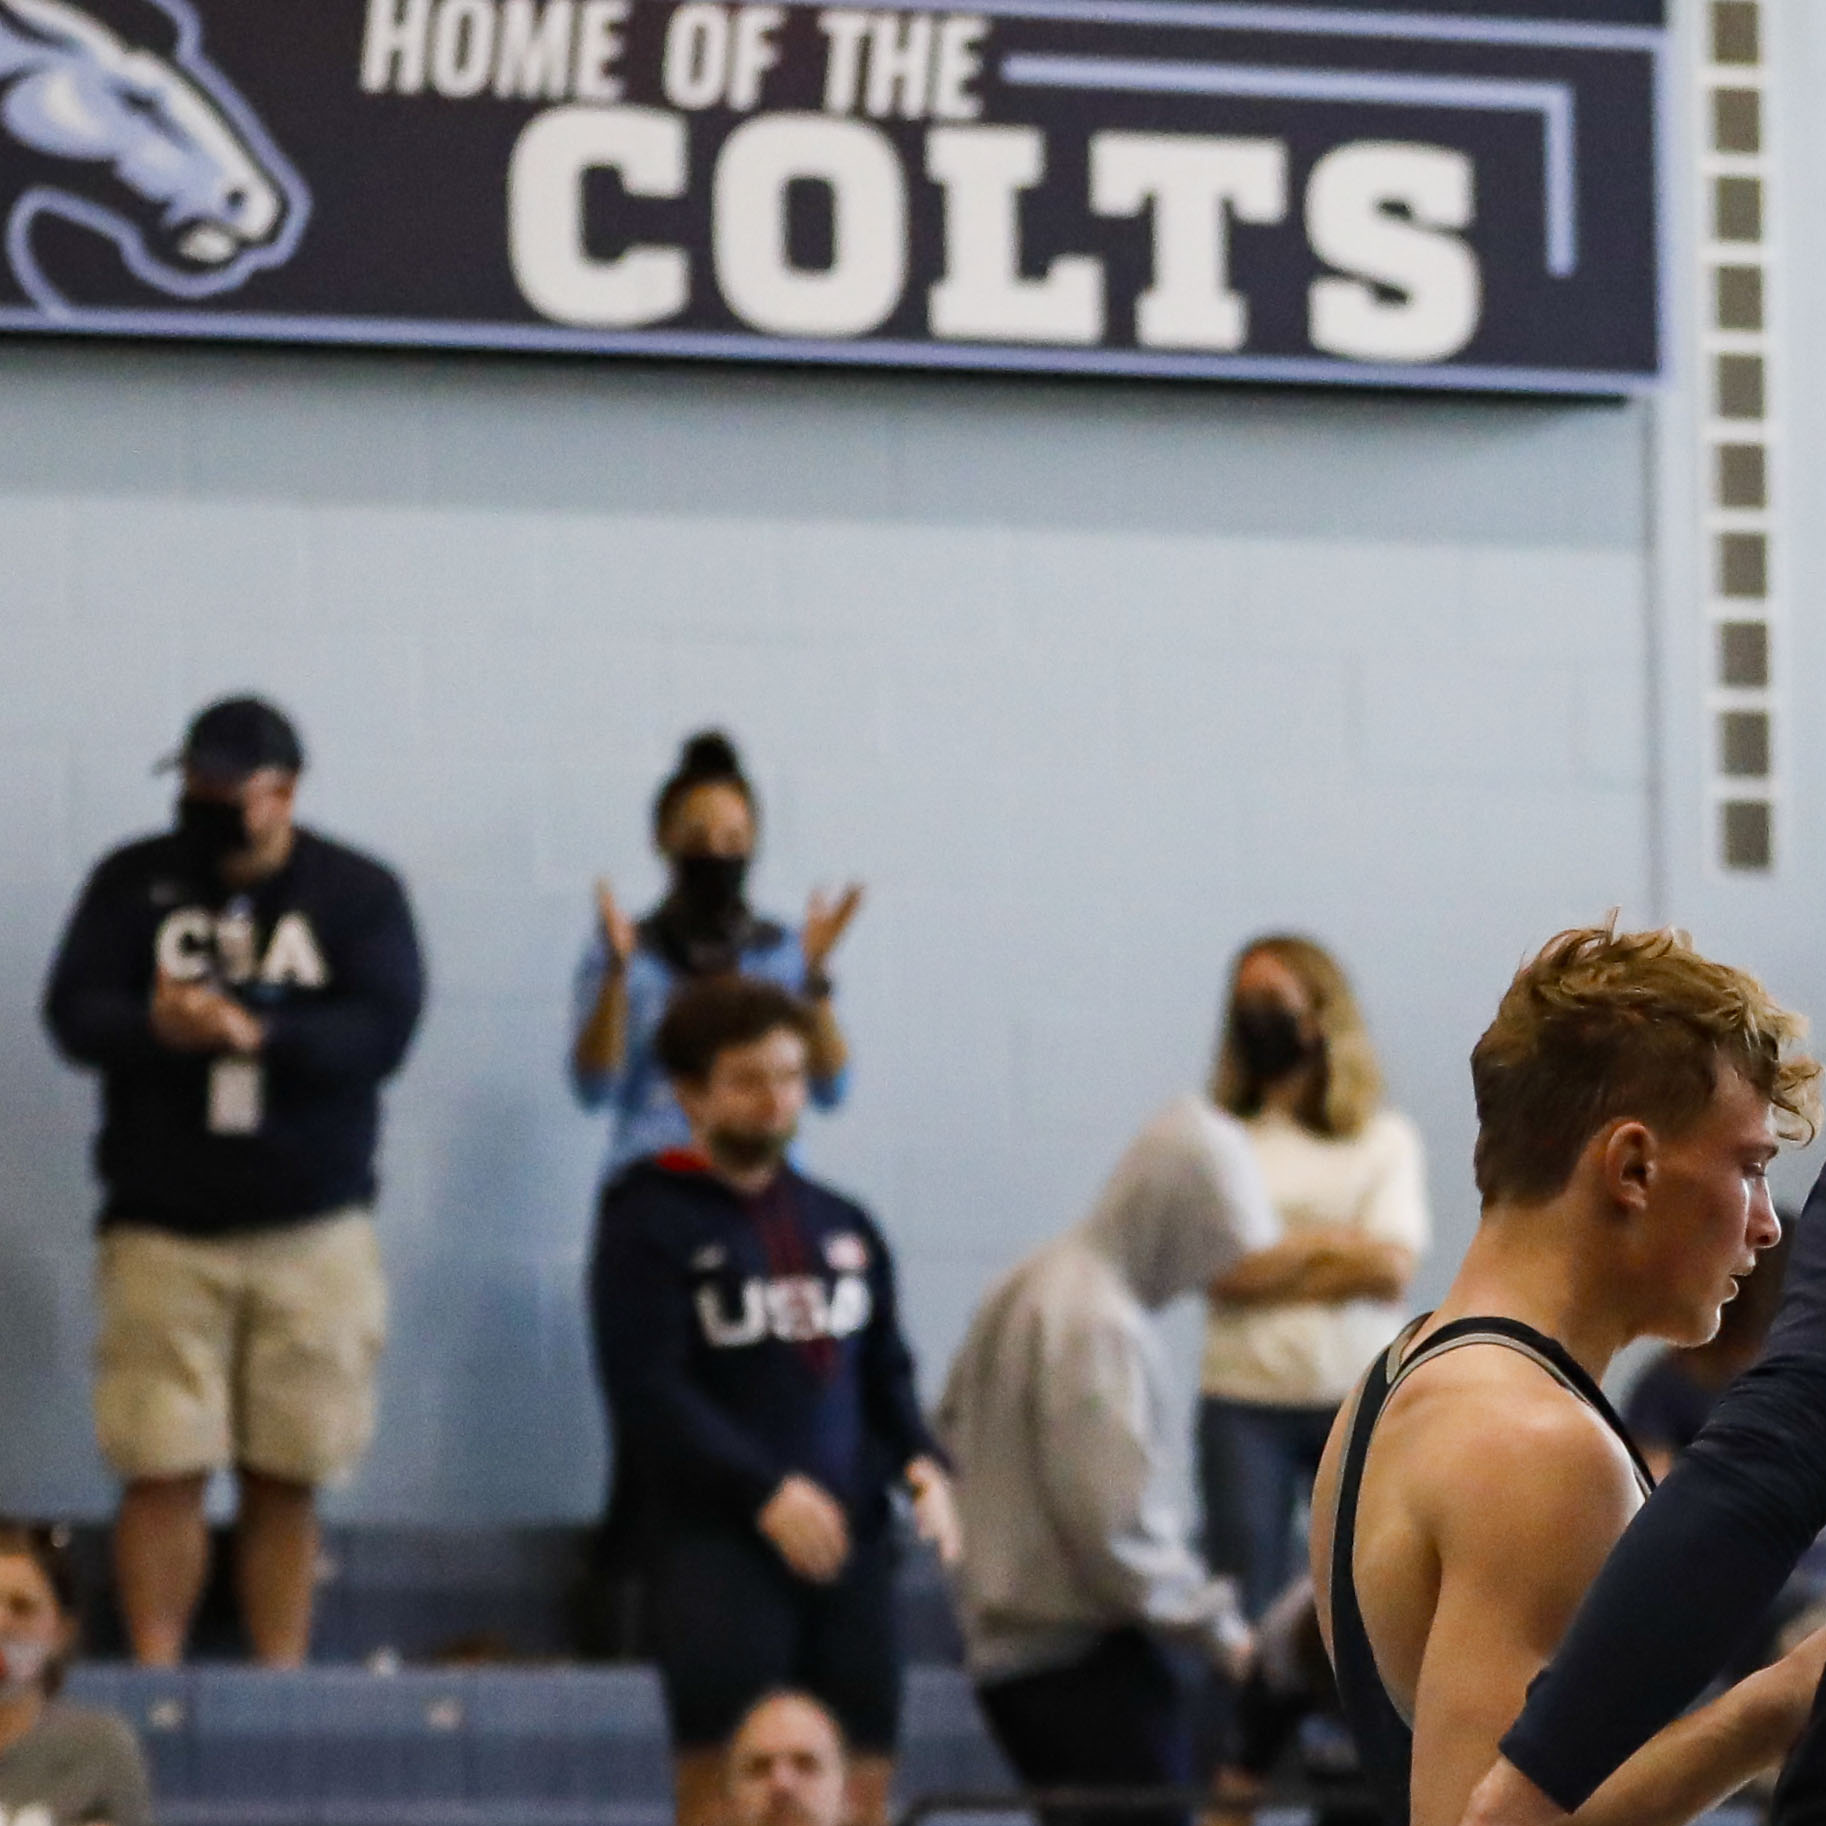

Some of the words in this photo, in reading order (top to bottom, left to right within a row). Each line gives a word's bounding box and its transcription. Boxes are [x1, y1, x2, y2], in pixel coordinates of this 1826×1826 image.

[359, 0, 627, 103] HOME
[661, 4, 785, 112] OF
[820, 13, 994, 121] THE
[506, 103, 1484, 363] COLTS
